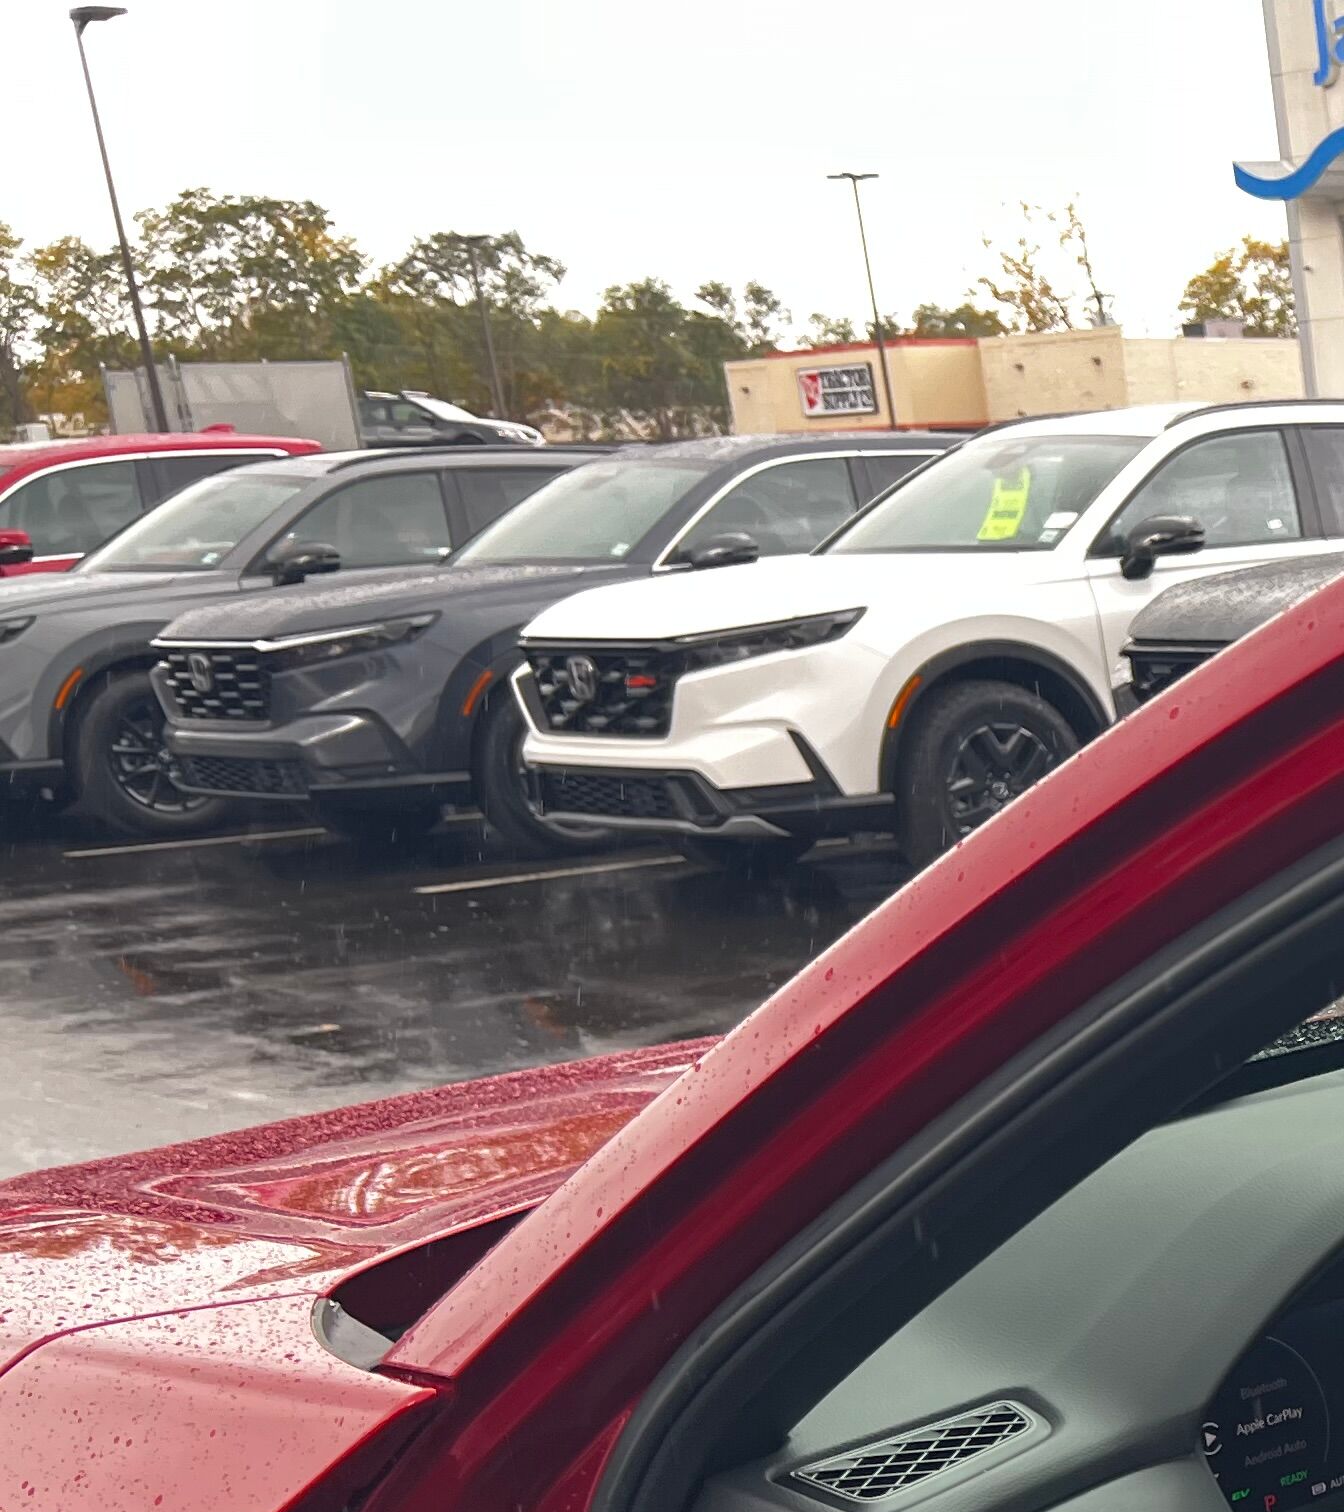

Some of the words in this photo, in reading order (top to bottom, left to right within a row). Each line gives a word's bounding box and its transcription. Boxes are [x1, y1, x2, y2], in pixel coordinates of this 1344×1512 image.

[1240, 1377, 1288, 1400] Bluetooth
[1236, 1416, 1265, 1436] Apple
[1266, 1407, 1303, 1426] CarPlay
[1244, 1445, 1283, 1467] Android
[1283, 1439, 1308, 1454] Auto
[1280, 1470, 1308, 1487] READY
[1264, 1494, 1276, 1512] P
